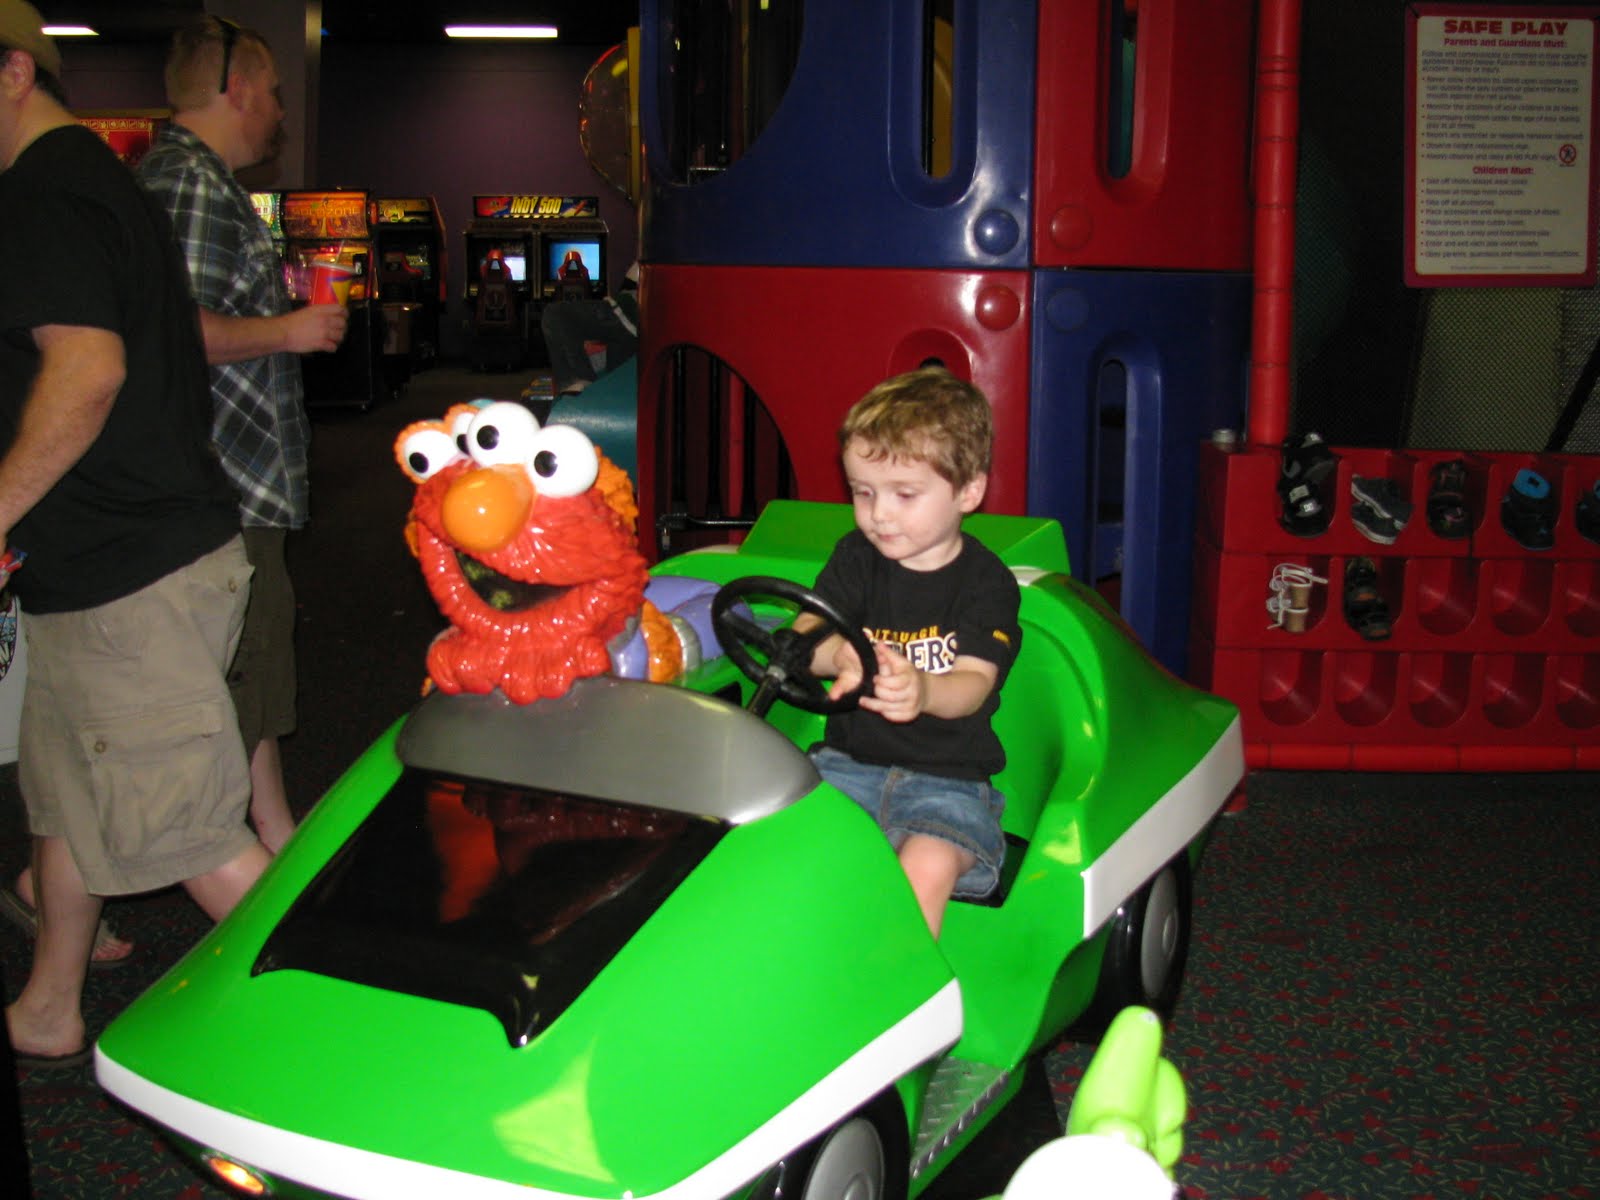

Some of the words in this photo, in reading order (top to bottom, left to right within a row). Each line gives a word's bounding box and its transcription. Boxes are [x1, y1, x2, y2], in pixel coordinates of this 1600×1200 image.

[1444, 19, 1503, 35] SAFE
[1511, 20, 1568, 36] PLAY
[1444, 38, 1478, 46] Parents
[1480, 38, 1496, 46] and
[1498, 39, 1541, 47] Guardians
[1473, 166, 1508, 175] Children
[1510, 166, 1534, 175] Must:
[510, 196, 539, 214] INDY
[538, 197, 563, 214] 500
